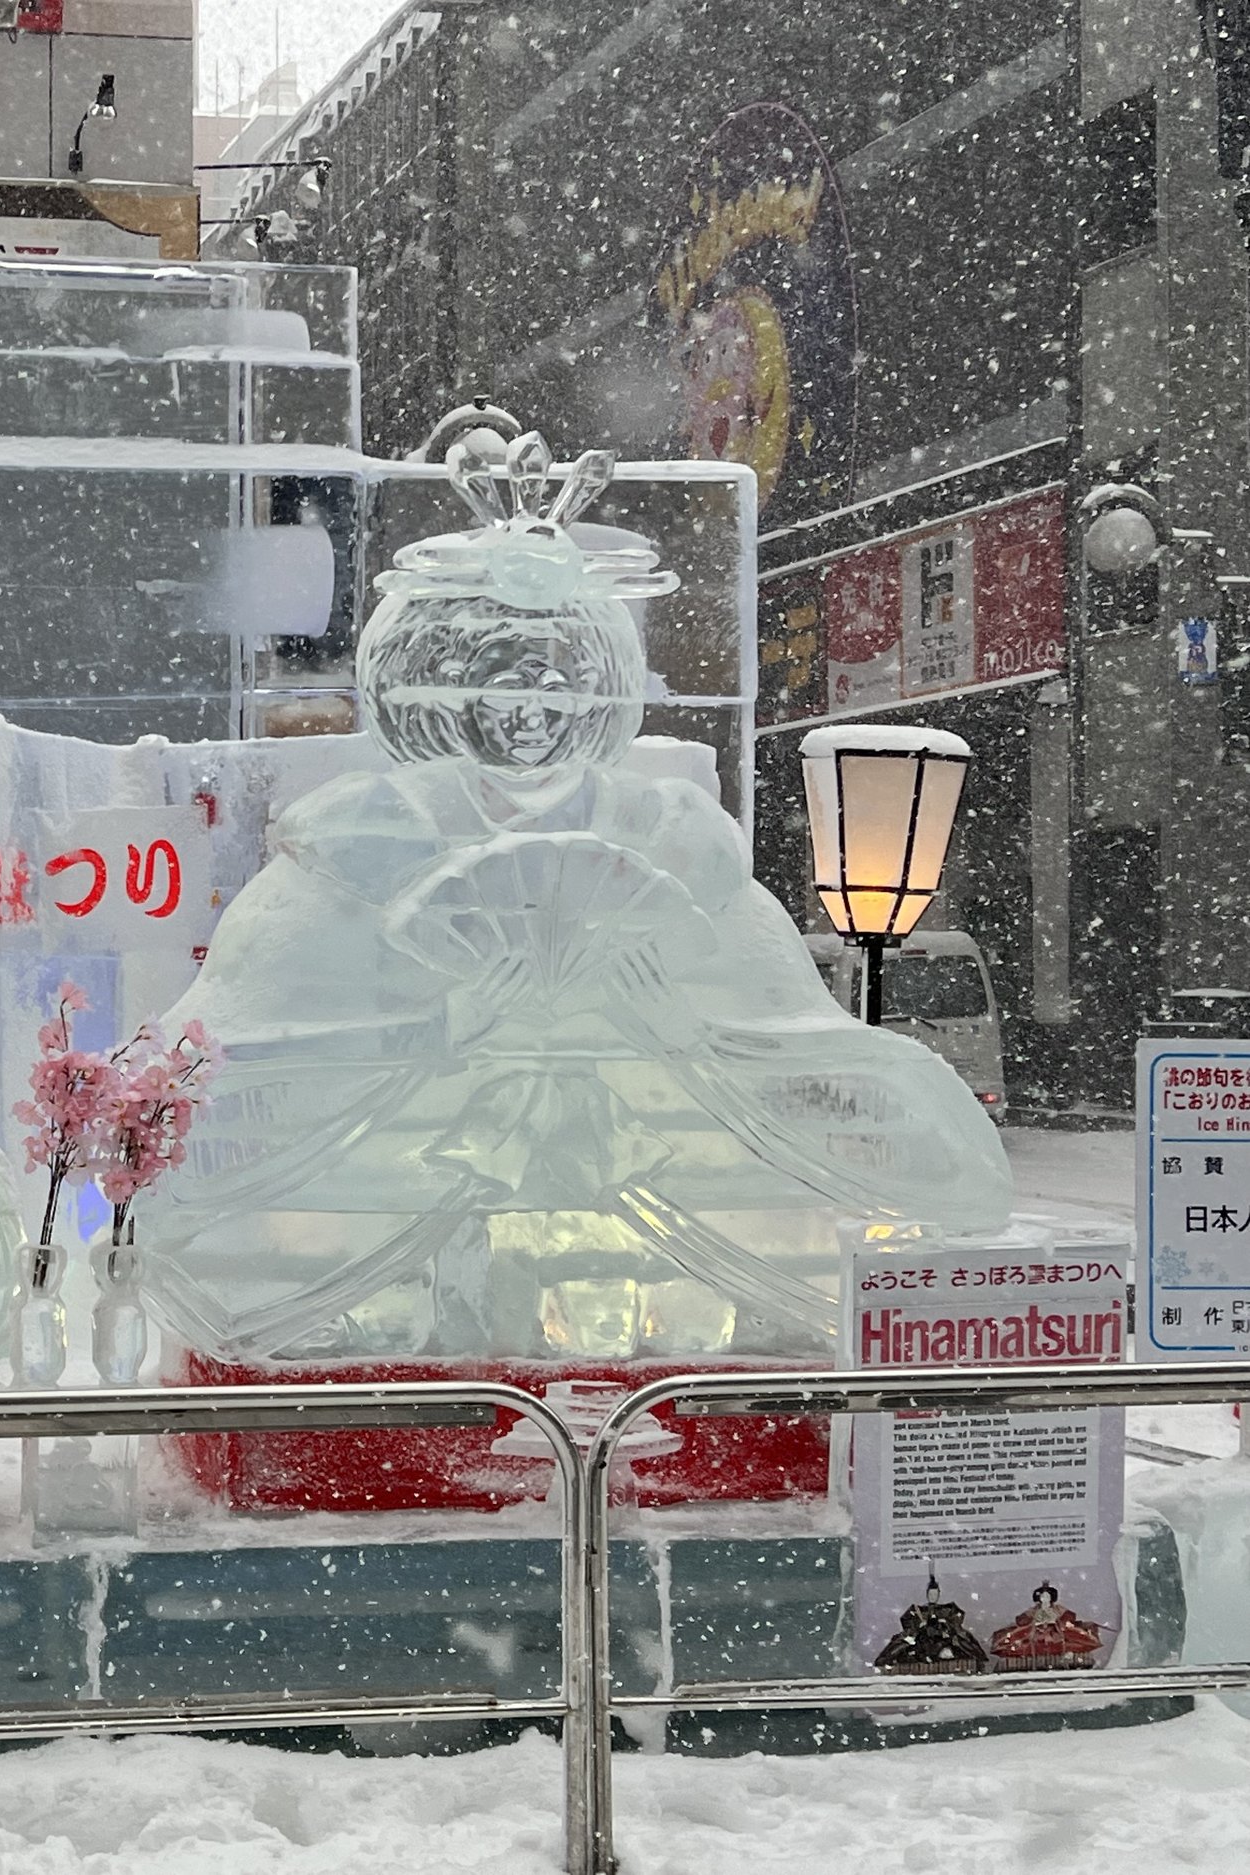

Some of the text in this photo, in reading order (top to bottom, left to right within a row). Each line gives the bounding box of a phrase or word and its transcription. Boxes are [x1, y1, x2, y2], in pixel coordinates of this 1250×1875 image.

[1163, 1066, 1250, 1088] 桃の節句を
[1197, 1116, 1220, 1131] Ice
[861, 1262, 1123, 1291] ようこそ さっぽろ雪まつりへ
[861, 1299, 1122, 1364] Hinamatsuri
